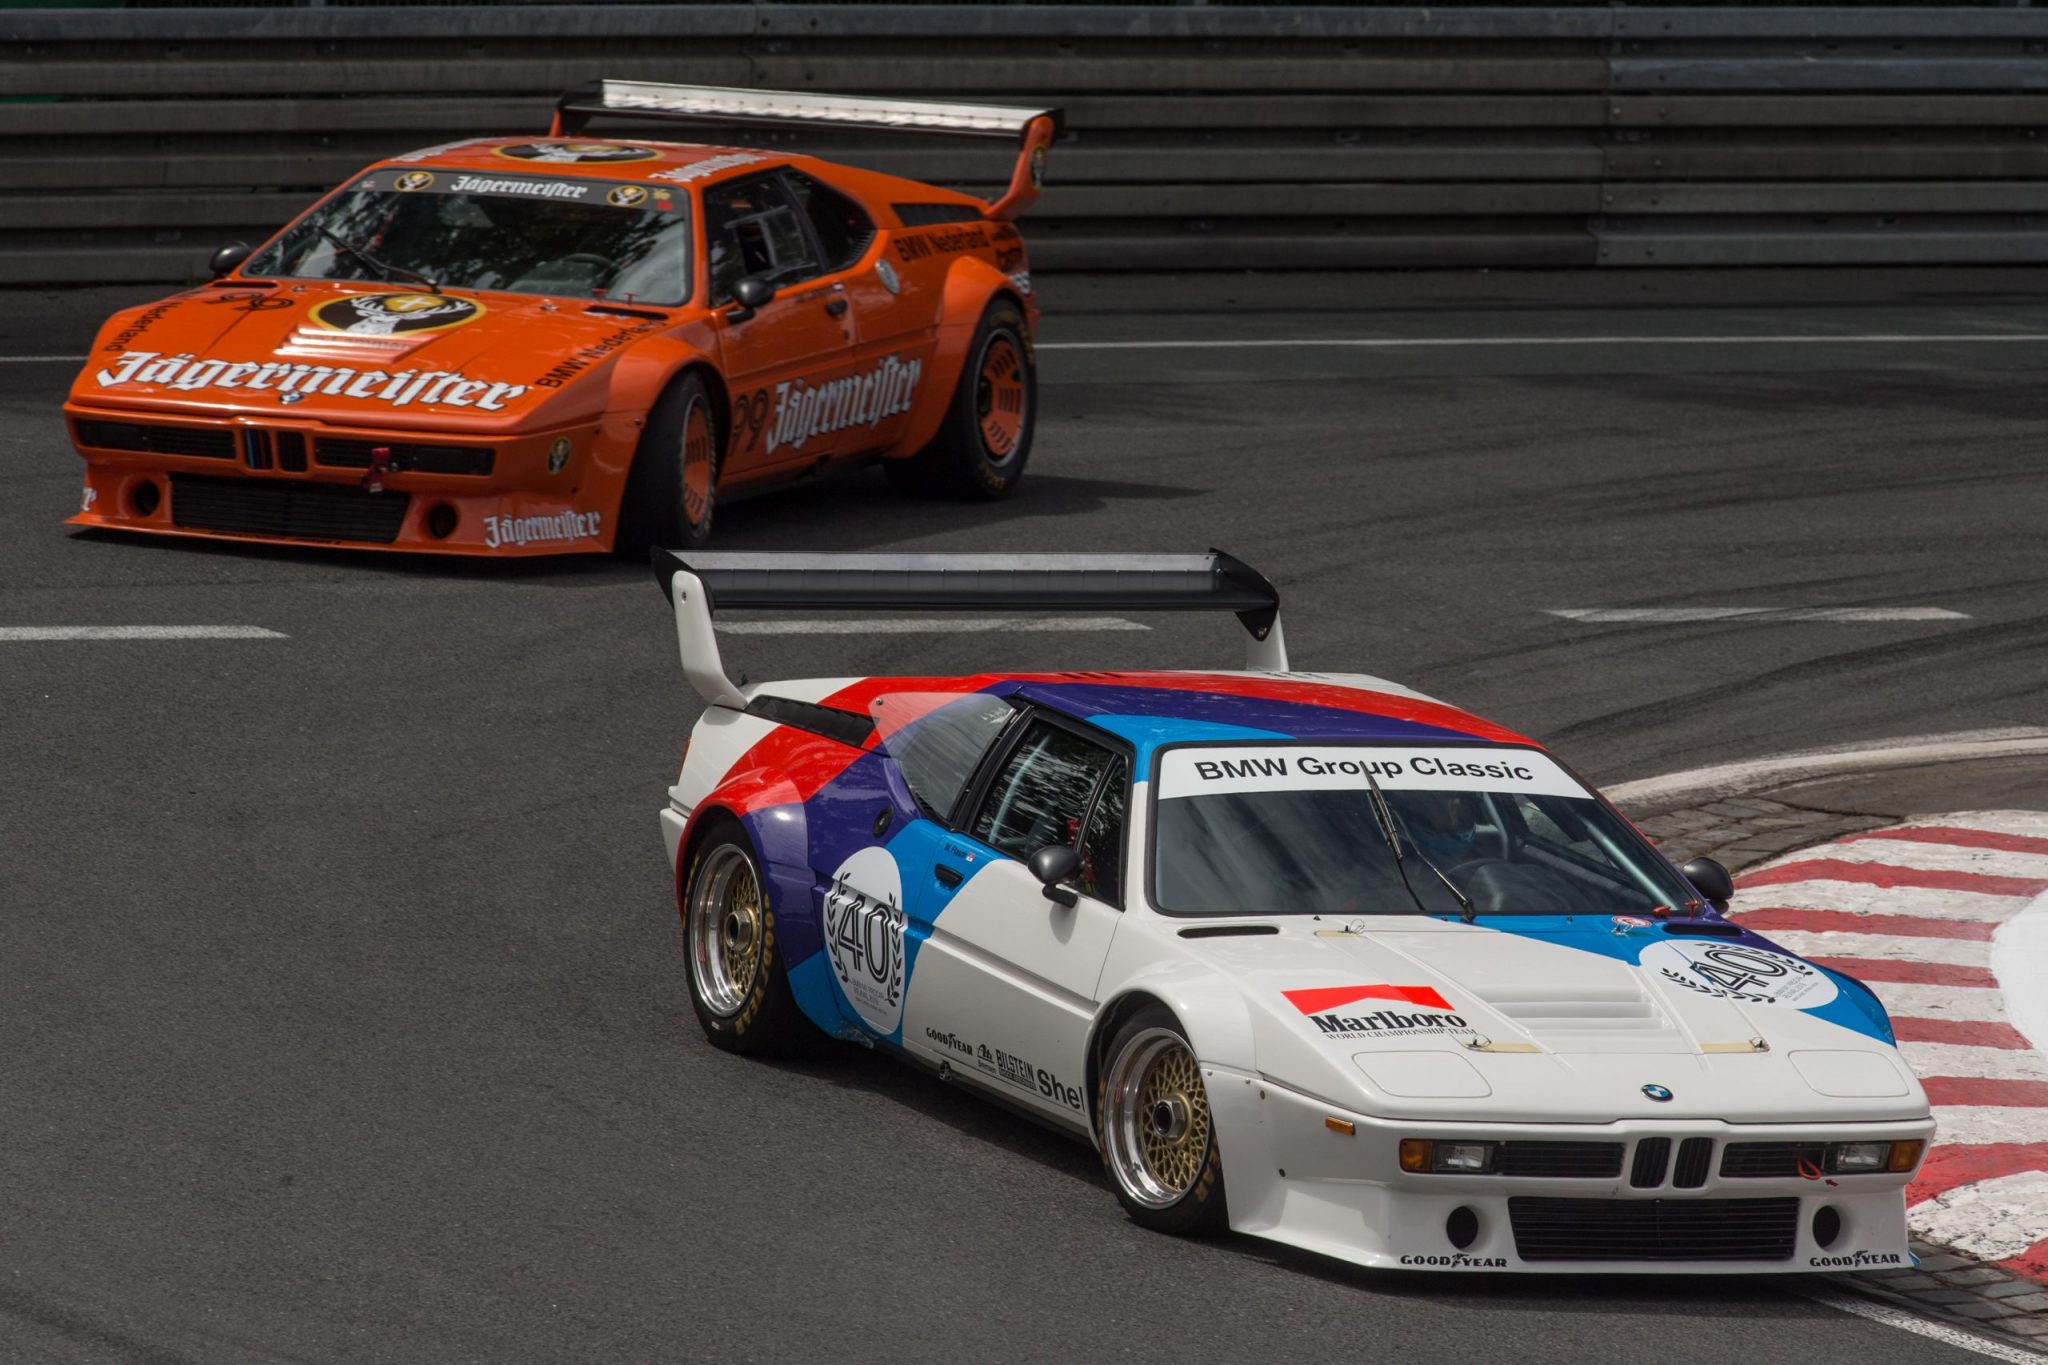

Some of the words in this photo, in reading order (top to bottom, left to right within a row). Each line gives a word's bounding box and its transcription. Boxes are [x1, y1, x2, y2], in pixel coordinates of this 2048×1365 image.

[450, 175, 588, 198] Jägermeister
[893, 235, 932, 262] BMW
[96, 350, 532, 413] Jägermeister
[534, 358, 590, 388] BMW
[765, 355, 923, 455] Jägermeister
[483, 509, 600, 548] Jägermeister
[1194, 757, 1288, 781] BMW
[1297, 756, 1403, 780] Group
[1409, 757, 1535, 781] Classic
[837, 893, 892, 984] 40
[1689, 949, 1788, 992] 40
[1308, 1010, 1468, 1034] Marlboro
[1326, 1030, 1367, 1041] WORLD
[1367, 1028, 1446, 1039] CHAMPIONSHIP
[1447, 1027, 1478, 1036] TEAM
[995, 1048, 1035, 1082] BILSTEIN
